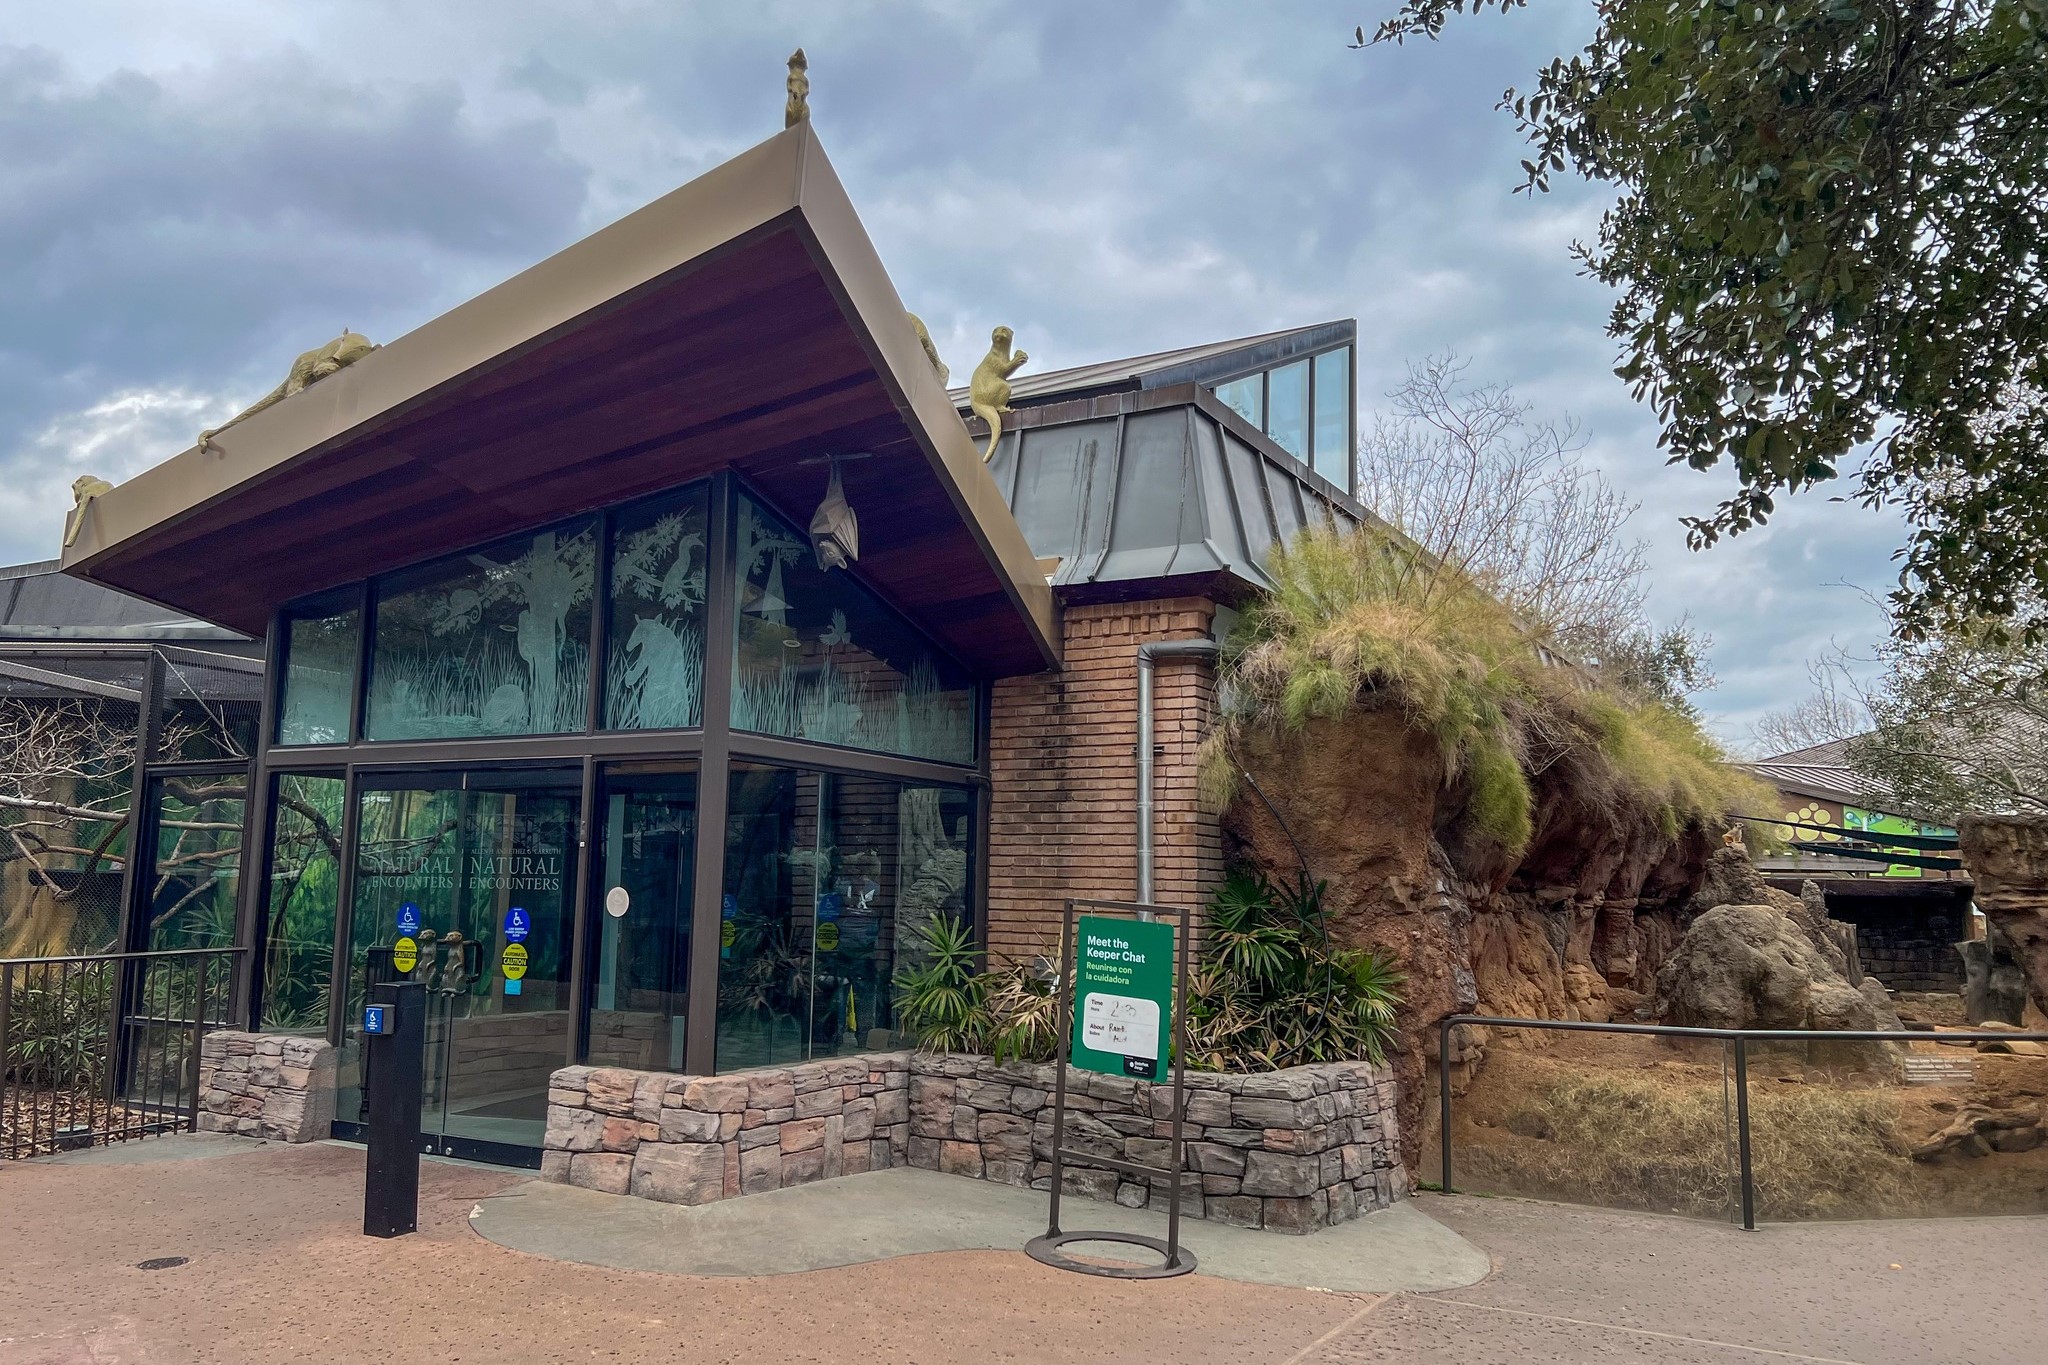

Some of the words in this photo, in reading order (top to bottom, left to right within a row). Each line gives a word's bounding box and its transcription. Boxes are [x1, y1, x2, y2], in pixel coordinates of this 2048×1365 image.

[373, 857, 454, 873] NATURAL
[470, 857, 560, 874] NATURAL
[372, 876, 454, 888] ENCOUNTERS
[469, 878, 559, 890] ENCOUNTERS
[1087, 935, 1111, 947] Meet
[1113, 938, 1129, 949] the
[1087, 947, 1120, 961] Keeper
[1122, 951, 1146, 963] Chat
[1086, 961, 1118, 972] Reunirse
[1086, 972, 1092, 980] la
[1093, 974, 1130, 984] cuidadora
